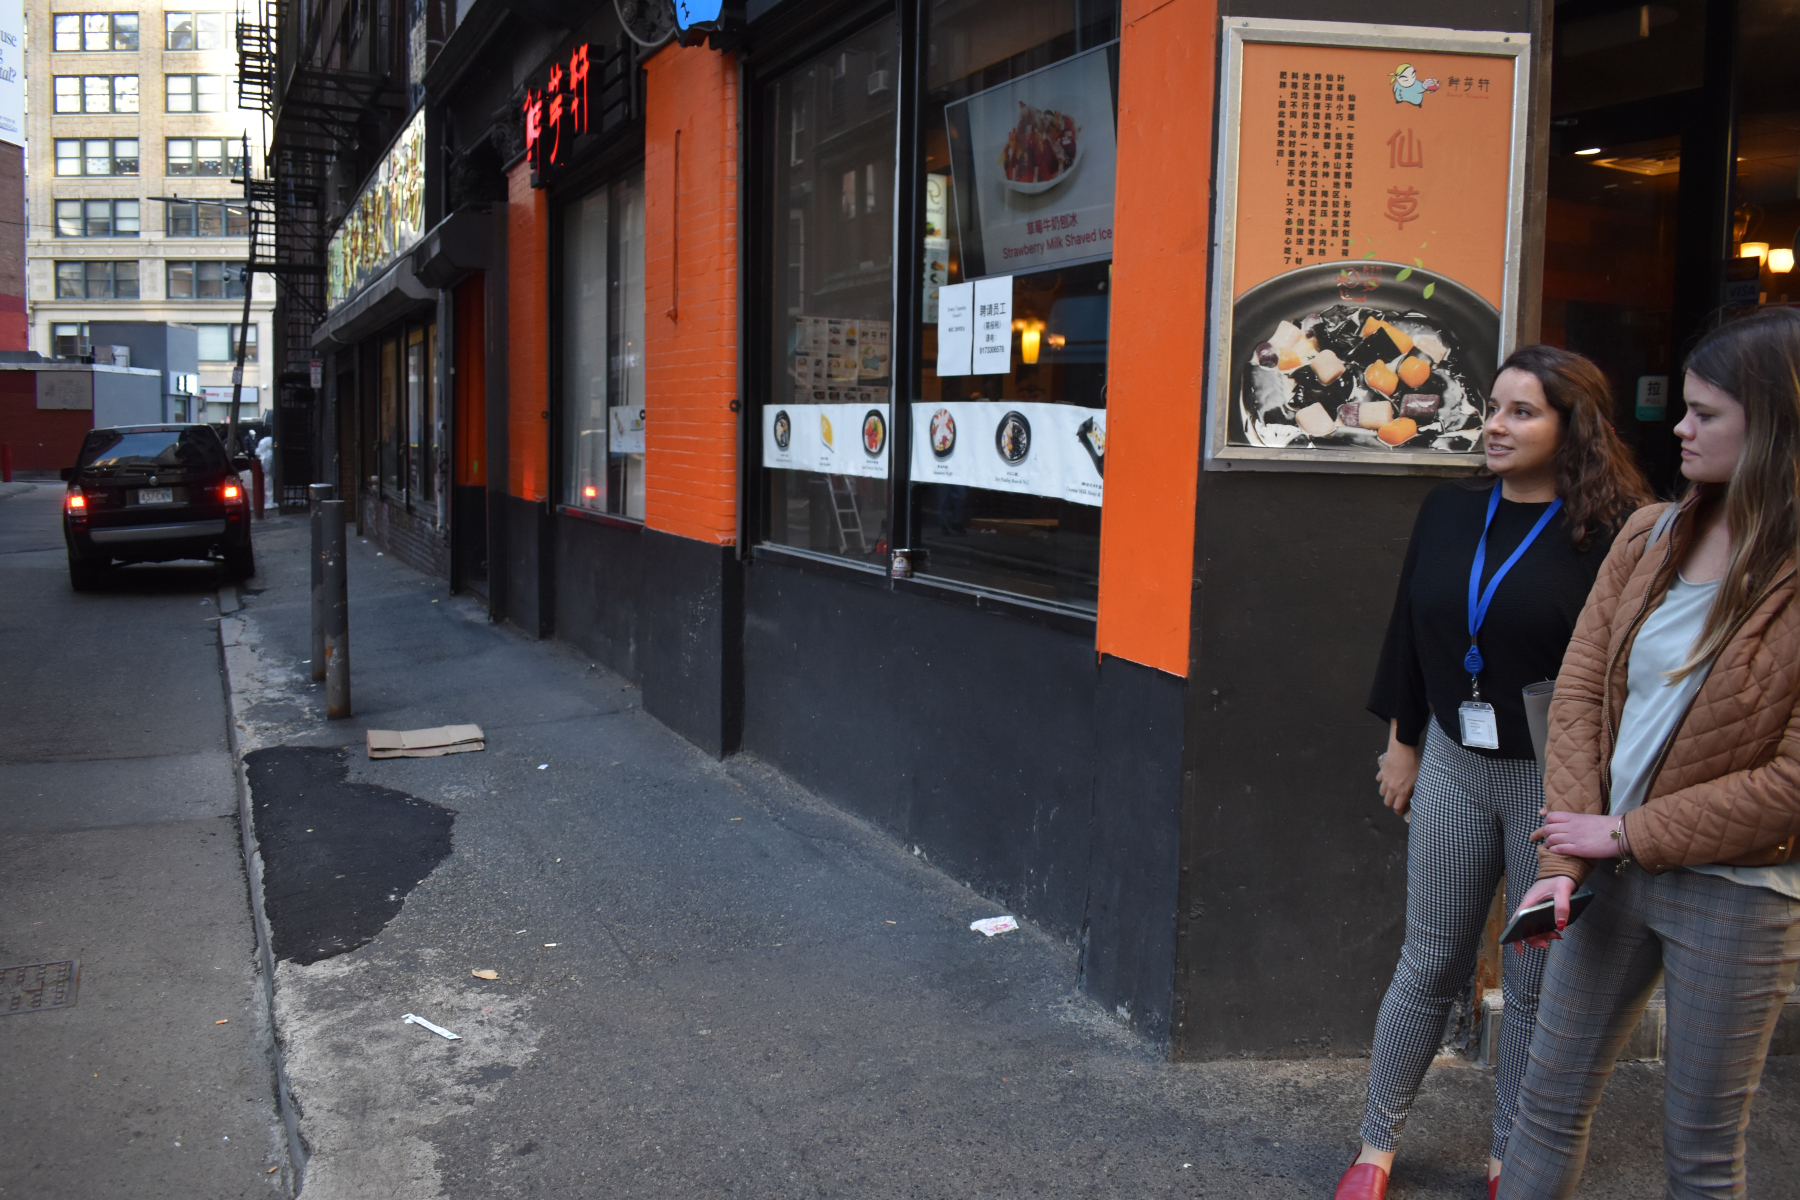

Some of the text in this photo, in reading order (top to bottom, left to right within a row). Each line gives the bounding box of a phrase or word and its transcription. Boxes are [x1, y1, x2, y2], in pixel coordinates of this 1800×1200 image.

[1384, 127, 1424, 231] 仙草
[1026, 211, 1078, 236] 草莓牛奶刨冰
[1003, 228, 1113, 260] Strawberry Milk Shaved Ice
[1647, 380, 1661, 396] 拉
